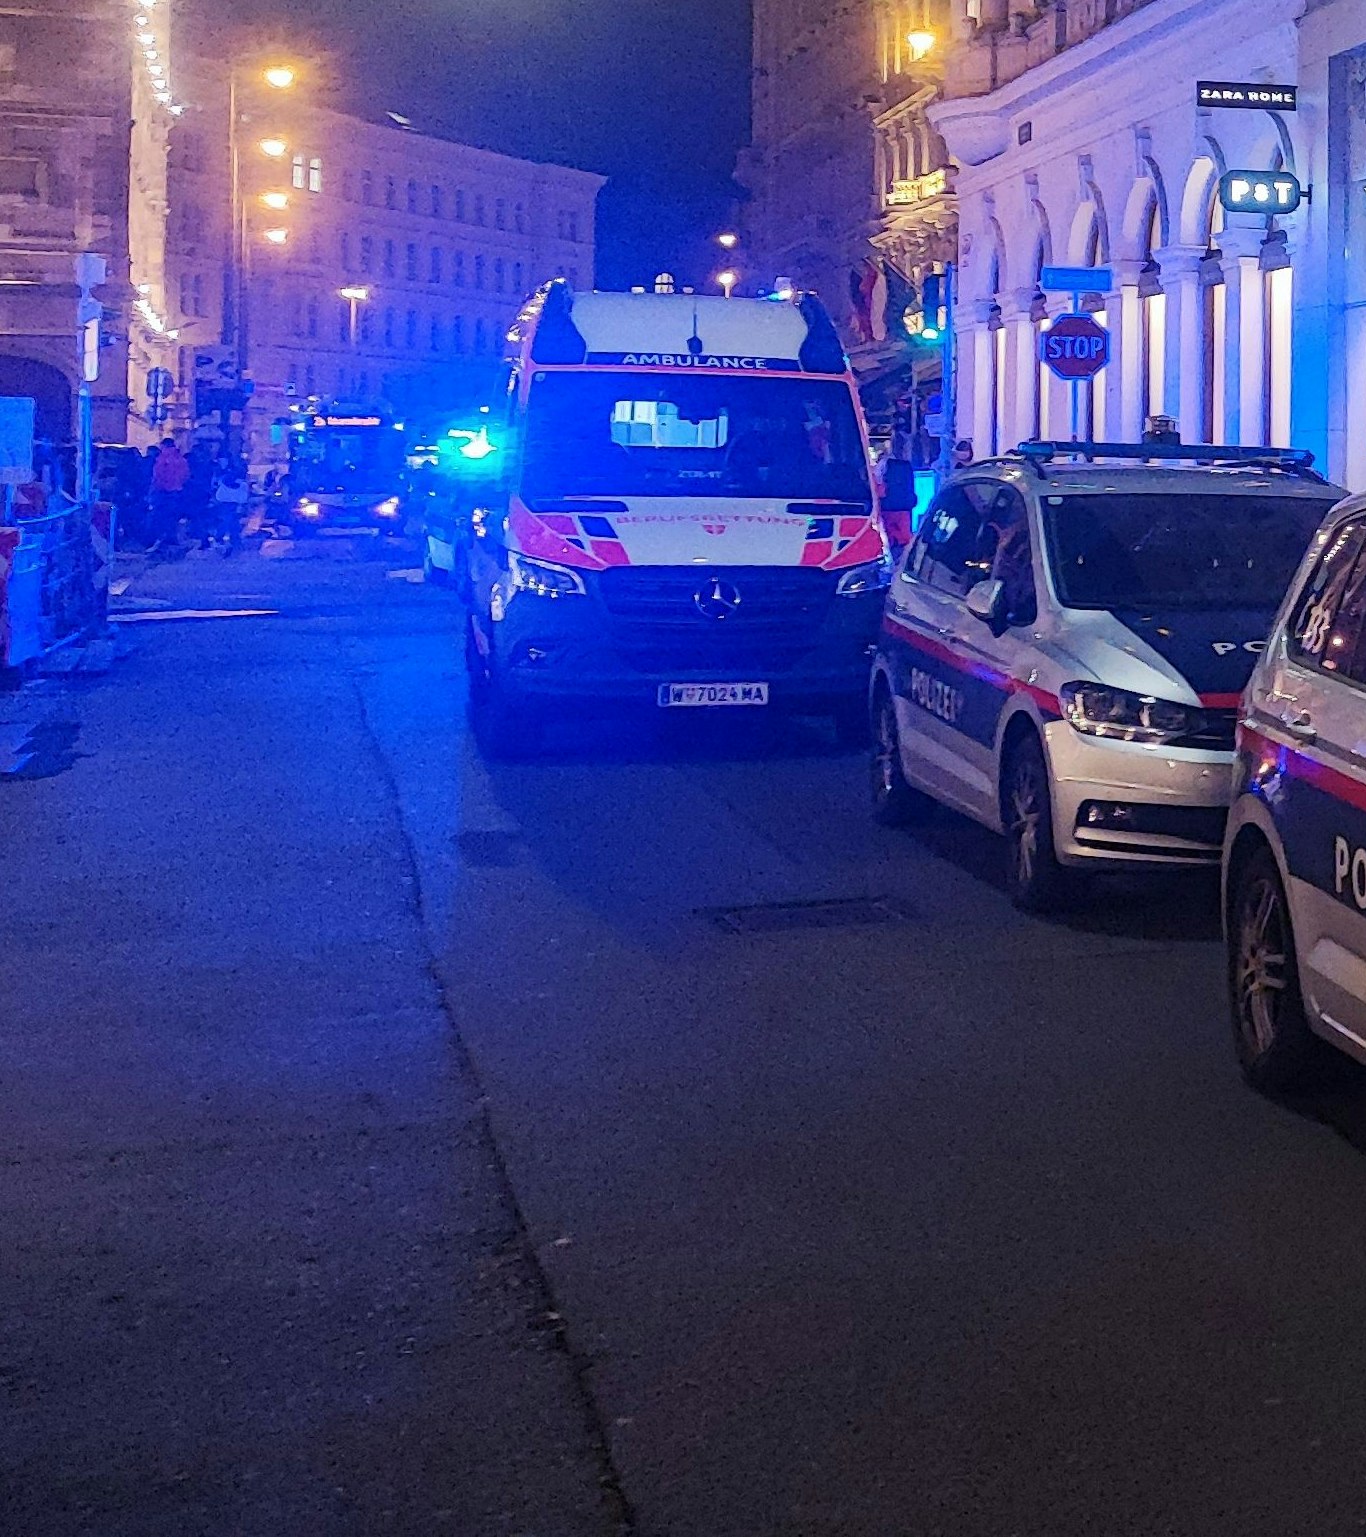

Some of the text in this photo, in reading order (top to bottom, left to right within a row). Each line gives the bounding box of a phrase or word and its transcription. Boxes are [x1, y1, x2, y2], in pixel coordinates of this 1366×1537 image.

[1200, 89, 1294, 103] ZARA HOME
[1048, 335, 1104, 359] STOP
[622, 353, 768, 369] AMBULANCE
